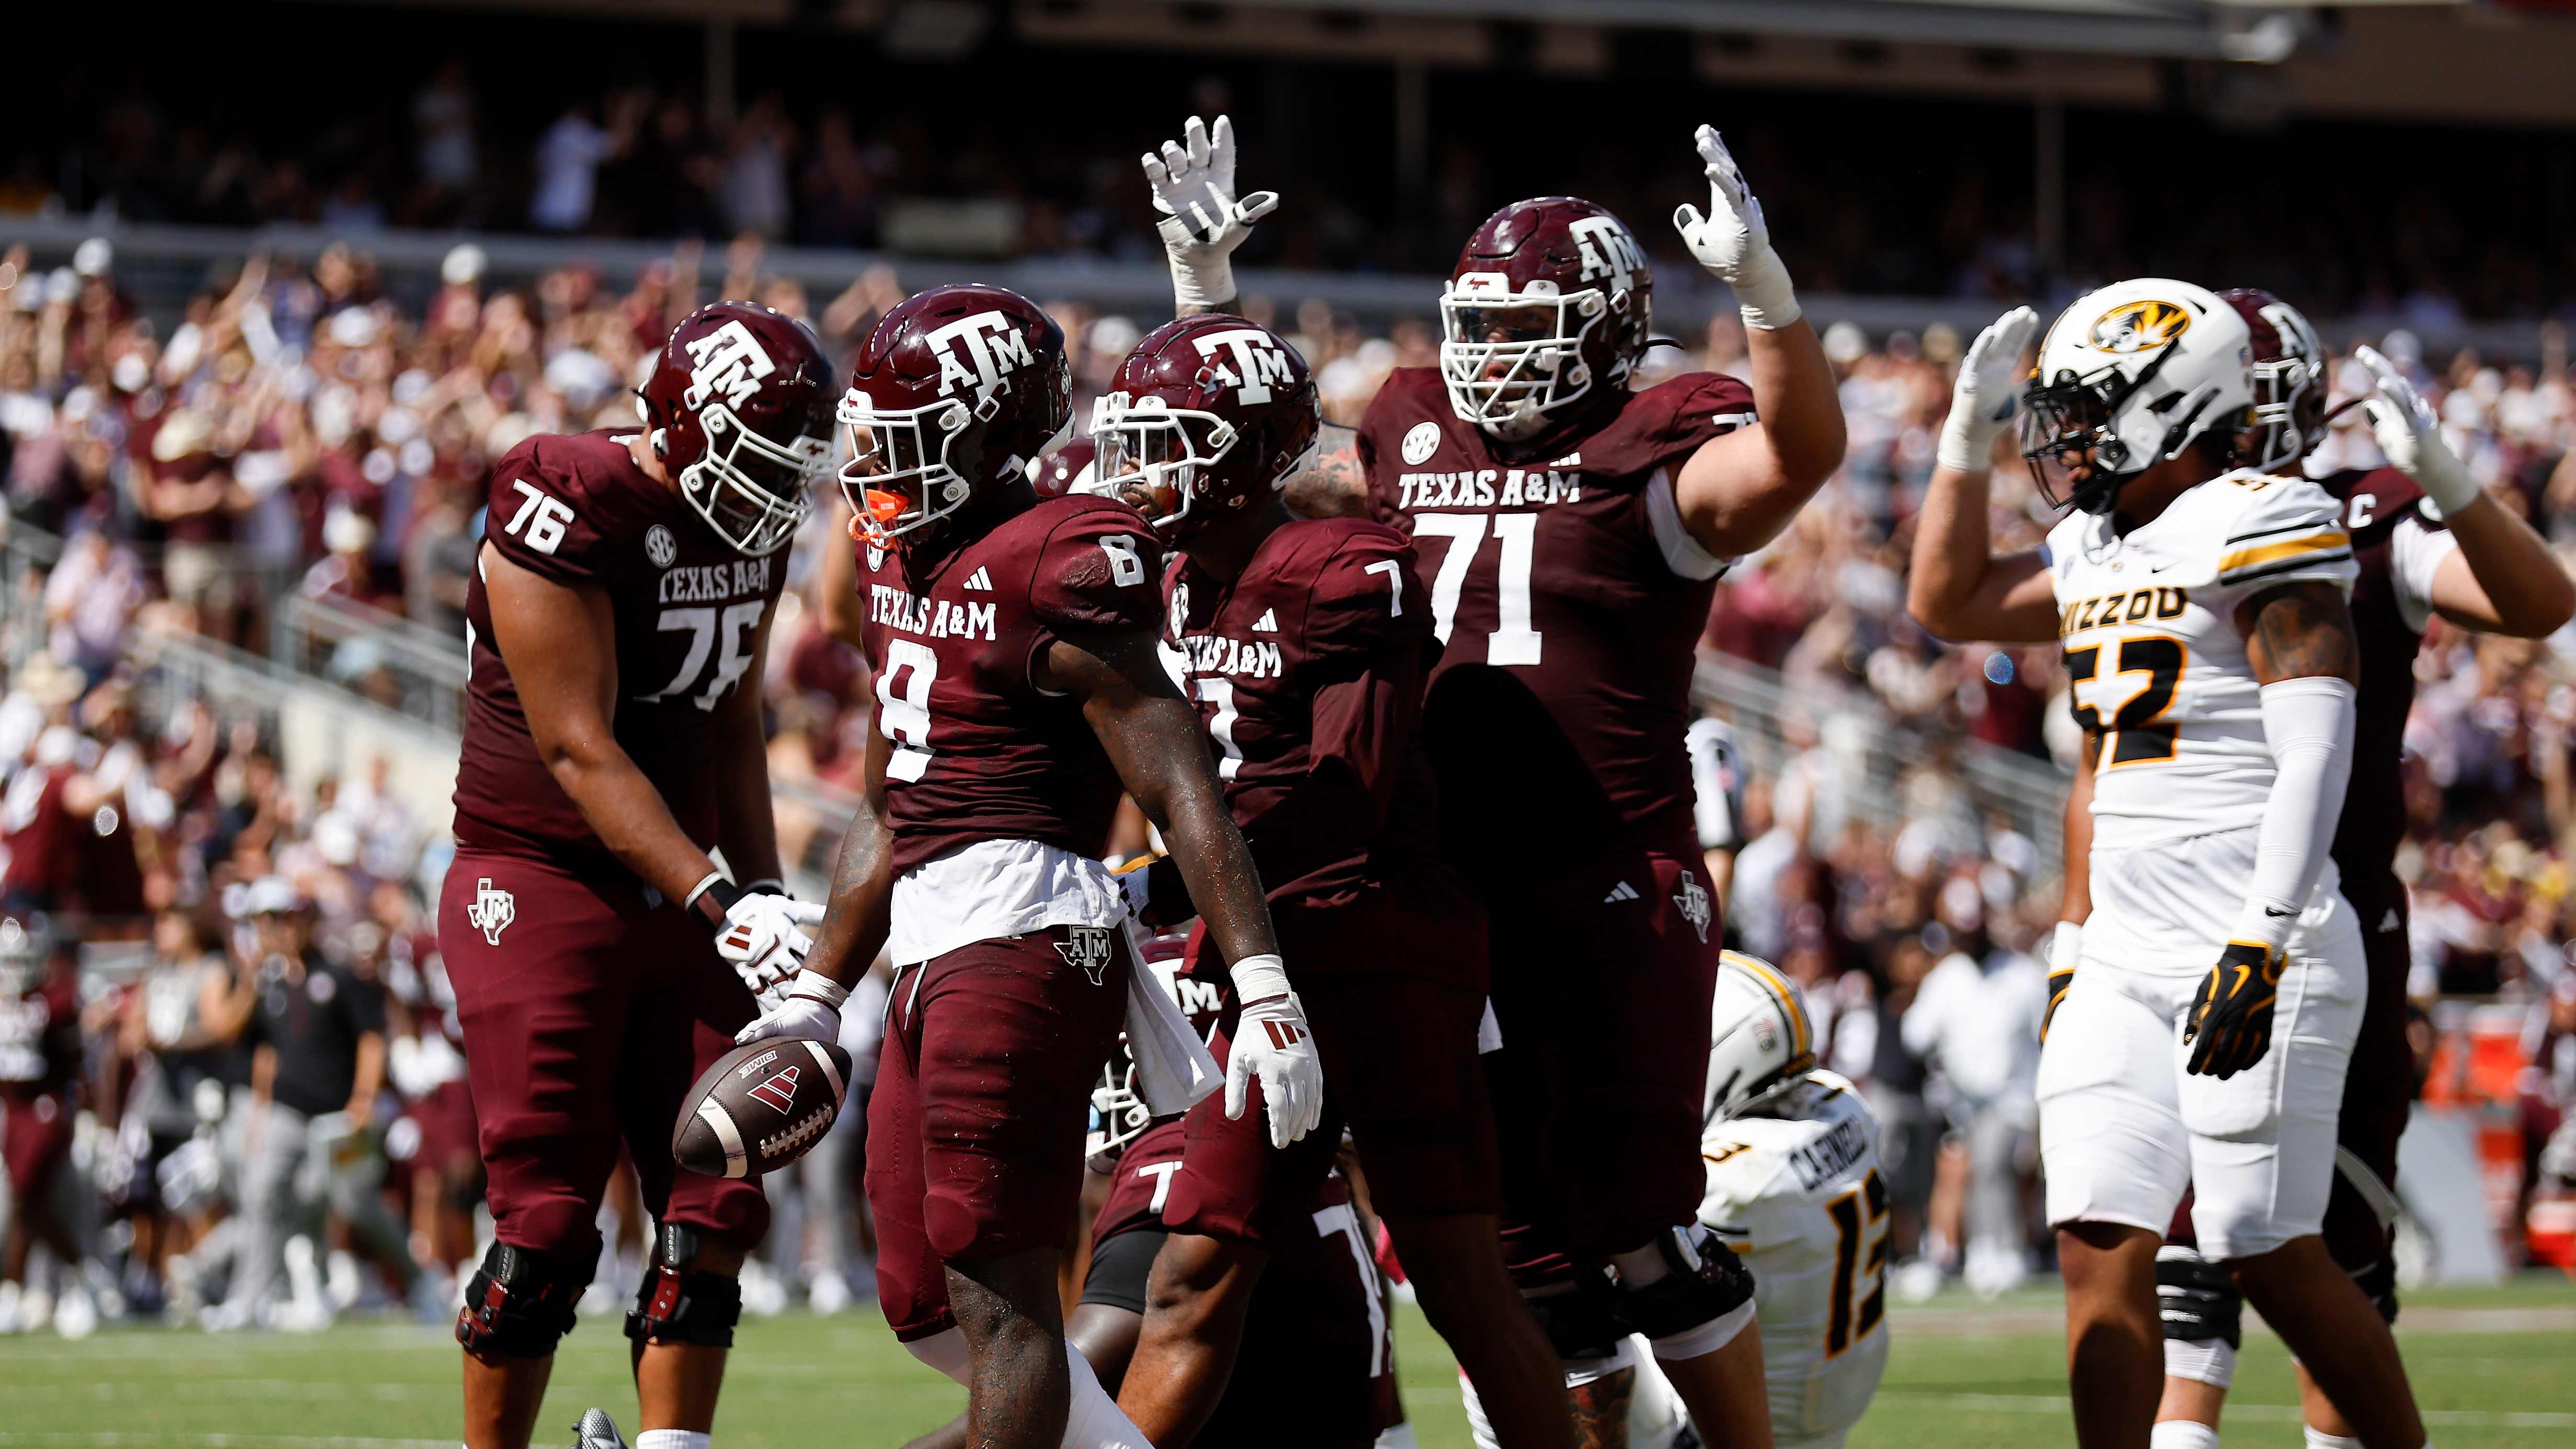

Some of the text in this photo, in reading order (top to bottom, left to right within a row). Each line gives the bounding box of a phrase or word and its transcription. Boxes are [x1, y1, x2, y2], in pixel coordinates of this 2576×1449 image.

[1398, 469, 1581, 510] TEXAS A&M
[2347, 493, 2377, 528] C
[504, 478, 575, 556] 76
[659, 563, 729, 604] TEXAS
[1099, 535, 1145, 587] 8
[871, 583, 996, 641] TEXAS A&M
[1364, 559, 1403, 617] 7
[1412, 513, 1542, 666] 71
[1218, 639, 1282, 678] A&M
[876, 638, 937, 783] 8
[738, 1050, 778, 1080] DIME
